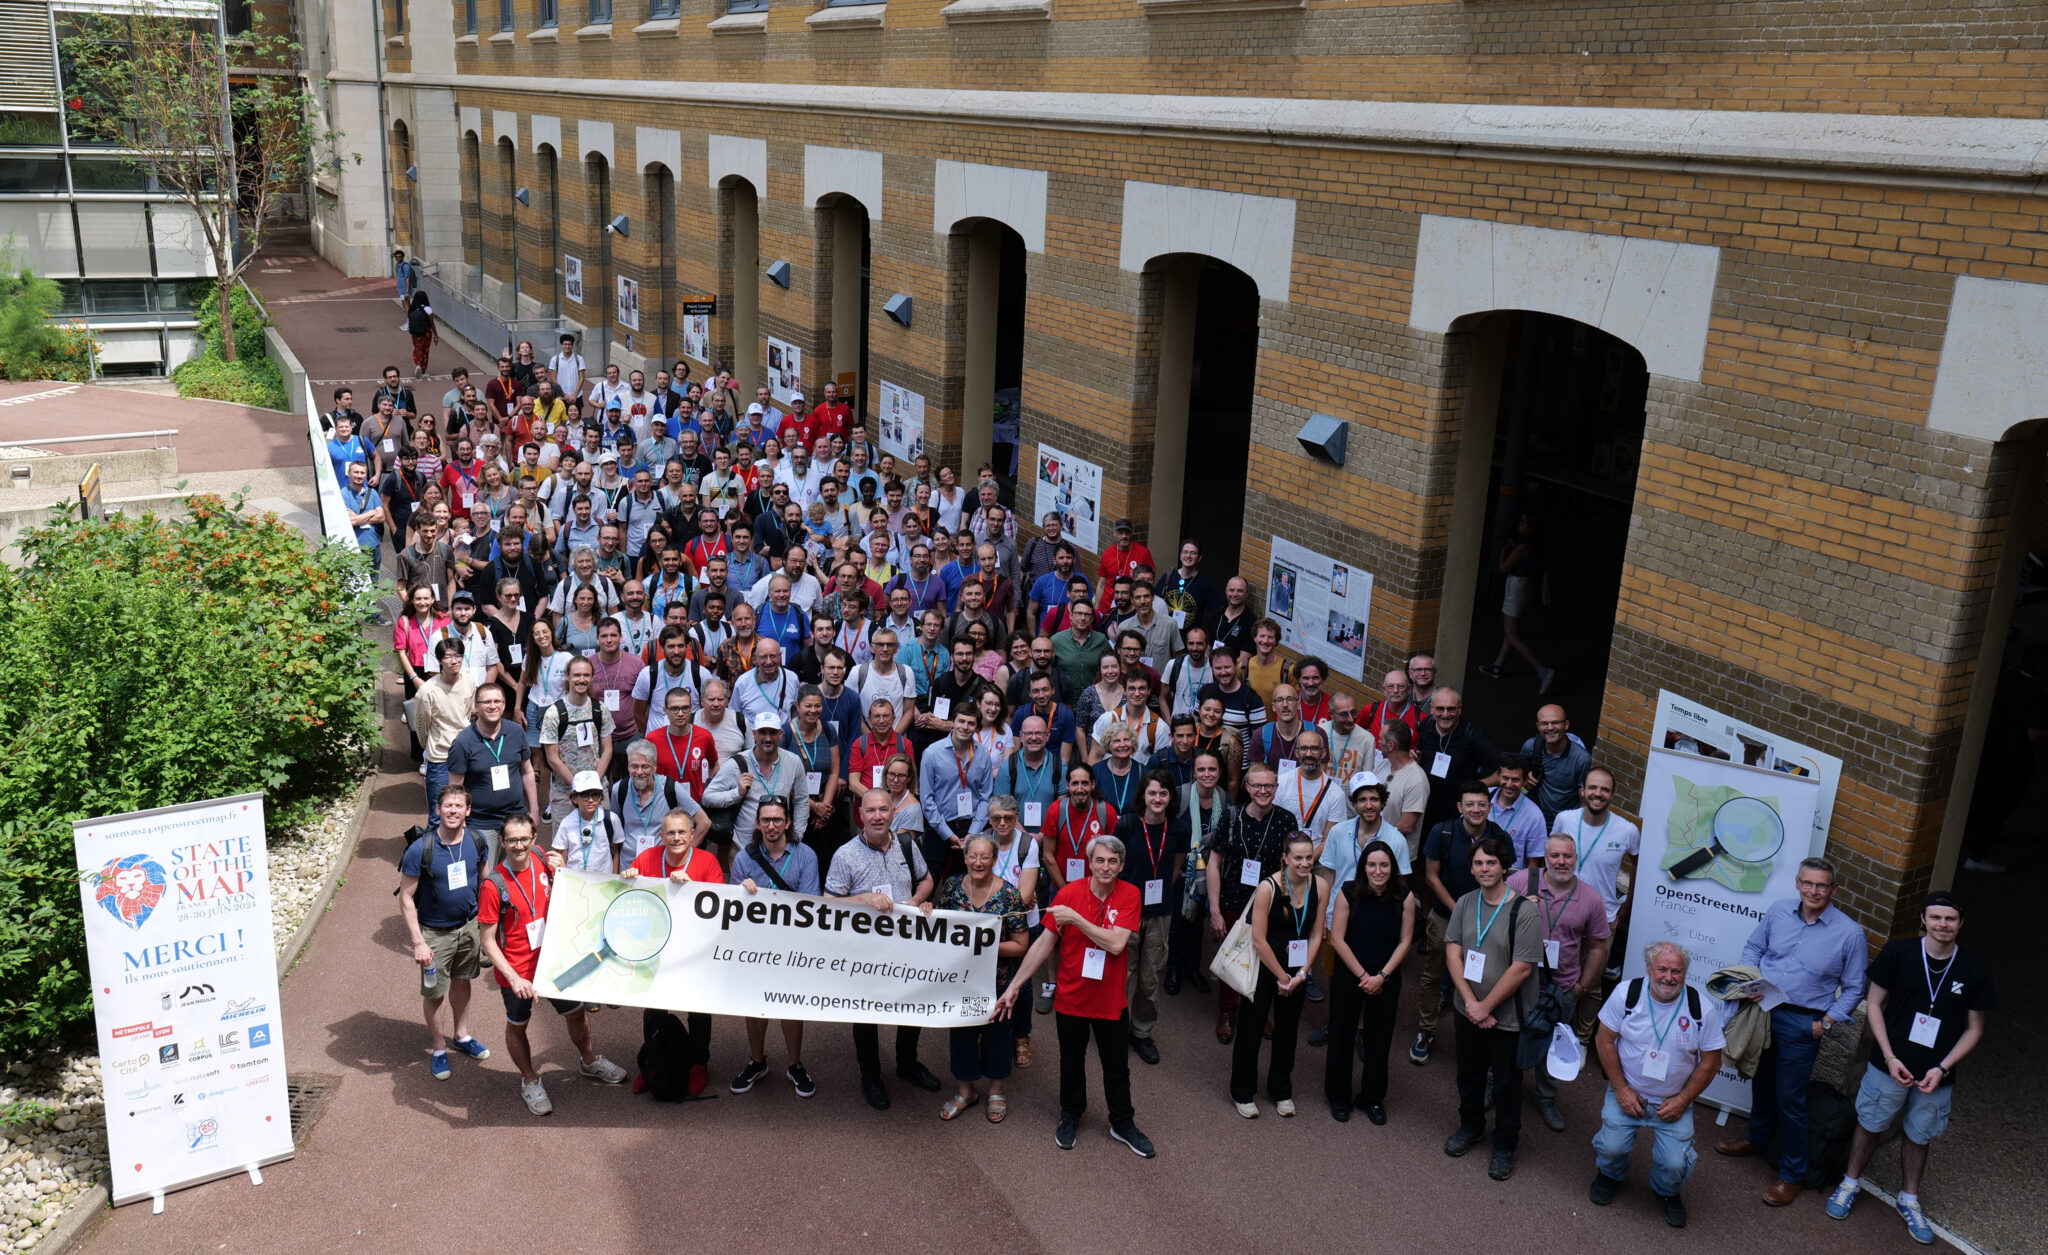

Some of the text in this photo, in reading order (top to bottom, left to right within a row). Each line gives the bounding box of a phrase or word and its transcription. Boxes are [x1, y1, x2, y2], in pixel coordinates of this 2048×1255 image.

[1671, 703, 1709, 724] Temps libre
[104, 811, 238, 840] sotm2024.openstreetmap.fr
[171, 835, 252, 866] STATE
[173, 854, 253, 882] OF THE
[176, 870, 254, 905] MAP
[176, 891, 256, 912] FRANCE LYON
[178, 901, 256, 922] 28-30 JUIN 2024
[1654, 896, 1697, 916] France
[694, 890, 996, 955] OpenStreetMap
[1689, 929, 1716, 944] Libre
[123, 931, 227, 973] MERCI
[125, 971, 139, 984] Ils
[142, 968, 169, 982] nous
[172, 954, 238, 973] soutiennent
[713, 945, 733, 961] La
[738, 949, 782, 966] carte
[787, 950, 826, 970] libre
[830, 956, 847, 972] et
[850, 958, 958, 984] participative
[221, 1006, 266, 1021] MICHELIN
[764, 990, 956, 1017] www.openstreetmap.fr
[112, 1058, 137, 1069] Carto
[189, 1053, 213, 1062] CORPUS
[236, 1057, 269, 1069] tomtom
[201, 1121, 215, 1131] 20
